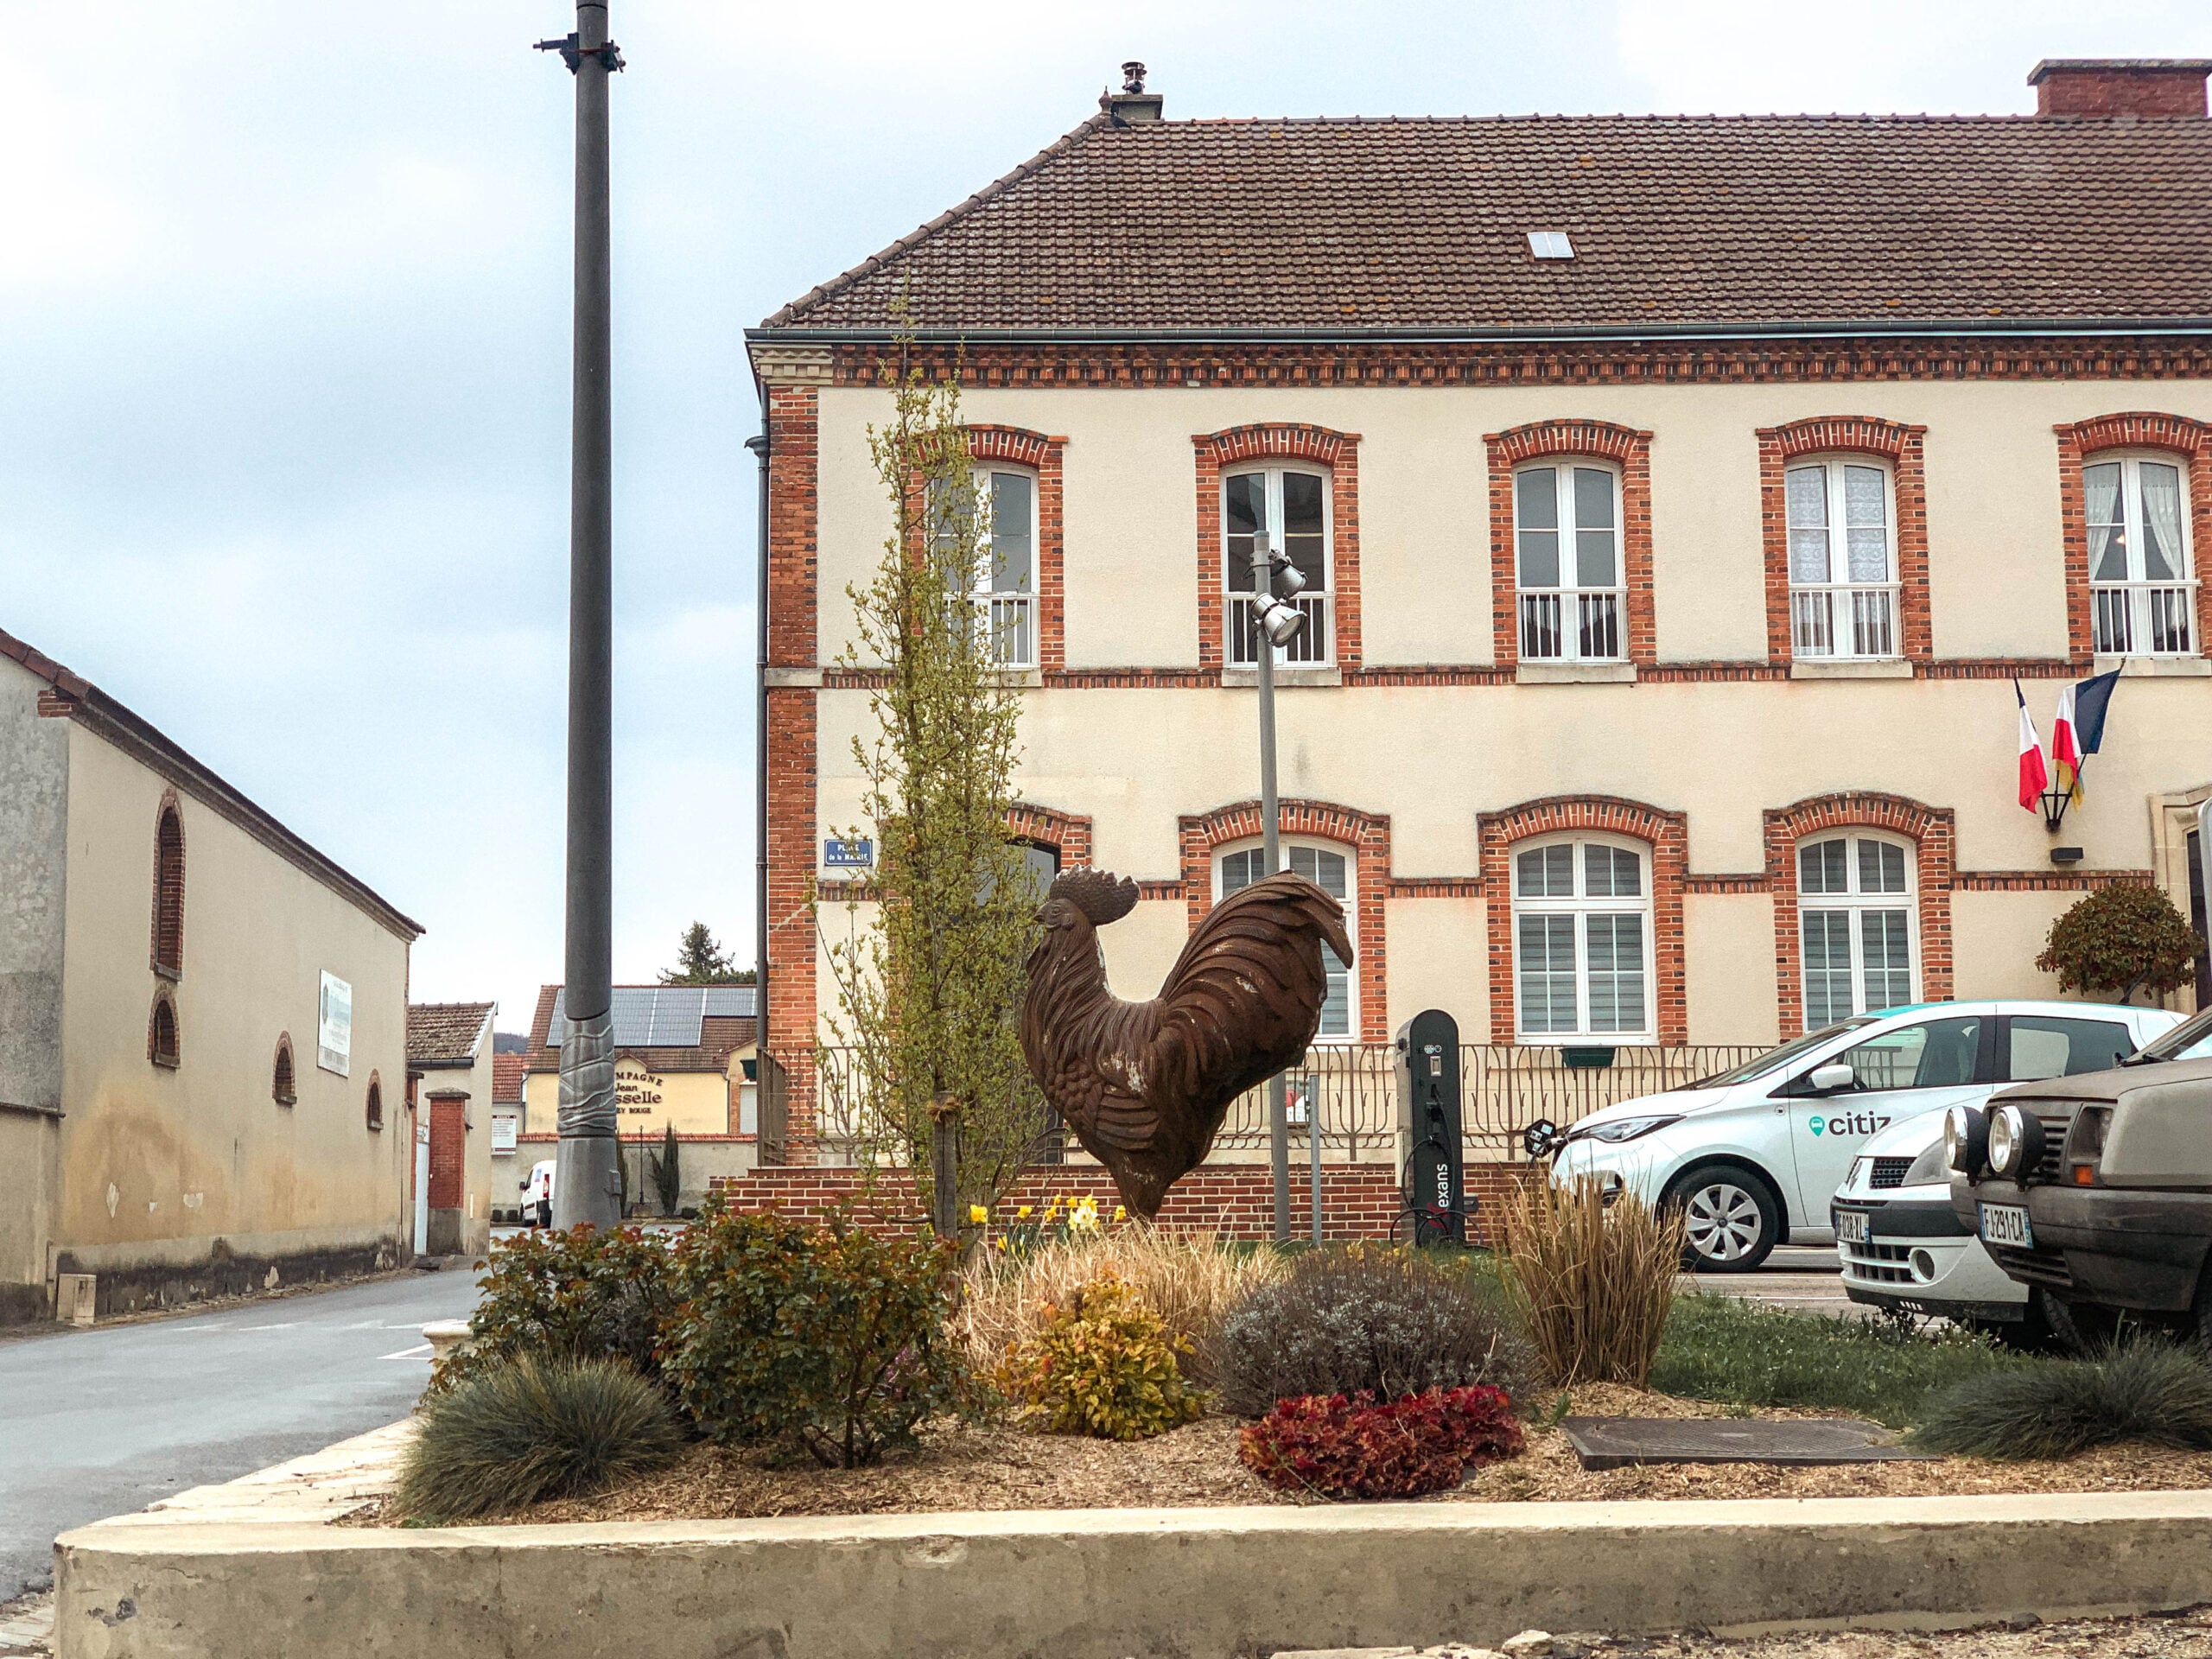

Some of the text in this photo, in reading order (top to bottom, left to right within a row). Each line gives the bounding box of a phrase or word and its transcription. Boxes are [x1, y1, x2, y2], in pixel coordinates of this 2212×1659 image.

[615, 1071, 663, 1086] MPAGNE
[615, 1083, 638, 1092] Jean
[615, 1090, 662, 1103] sselle
[1828, 1110, 1891, 1135] citiz
